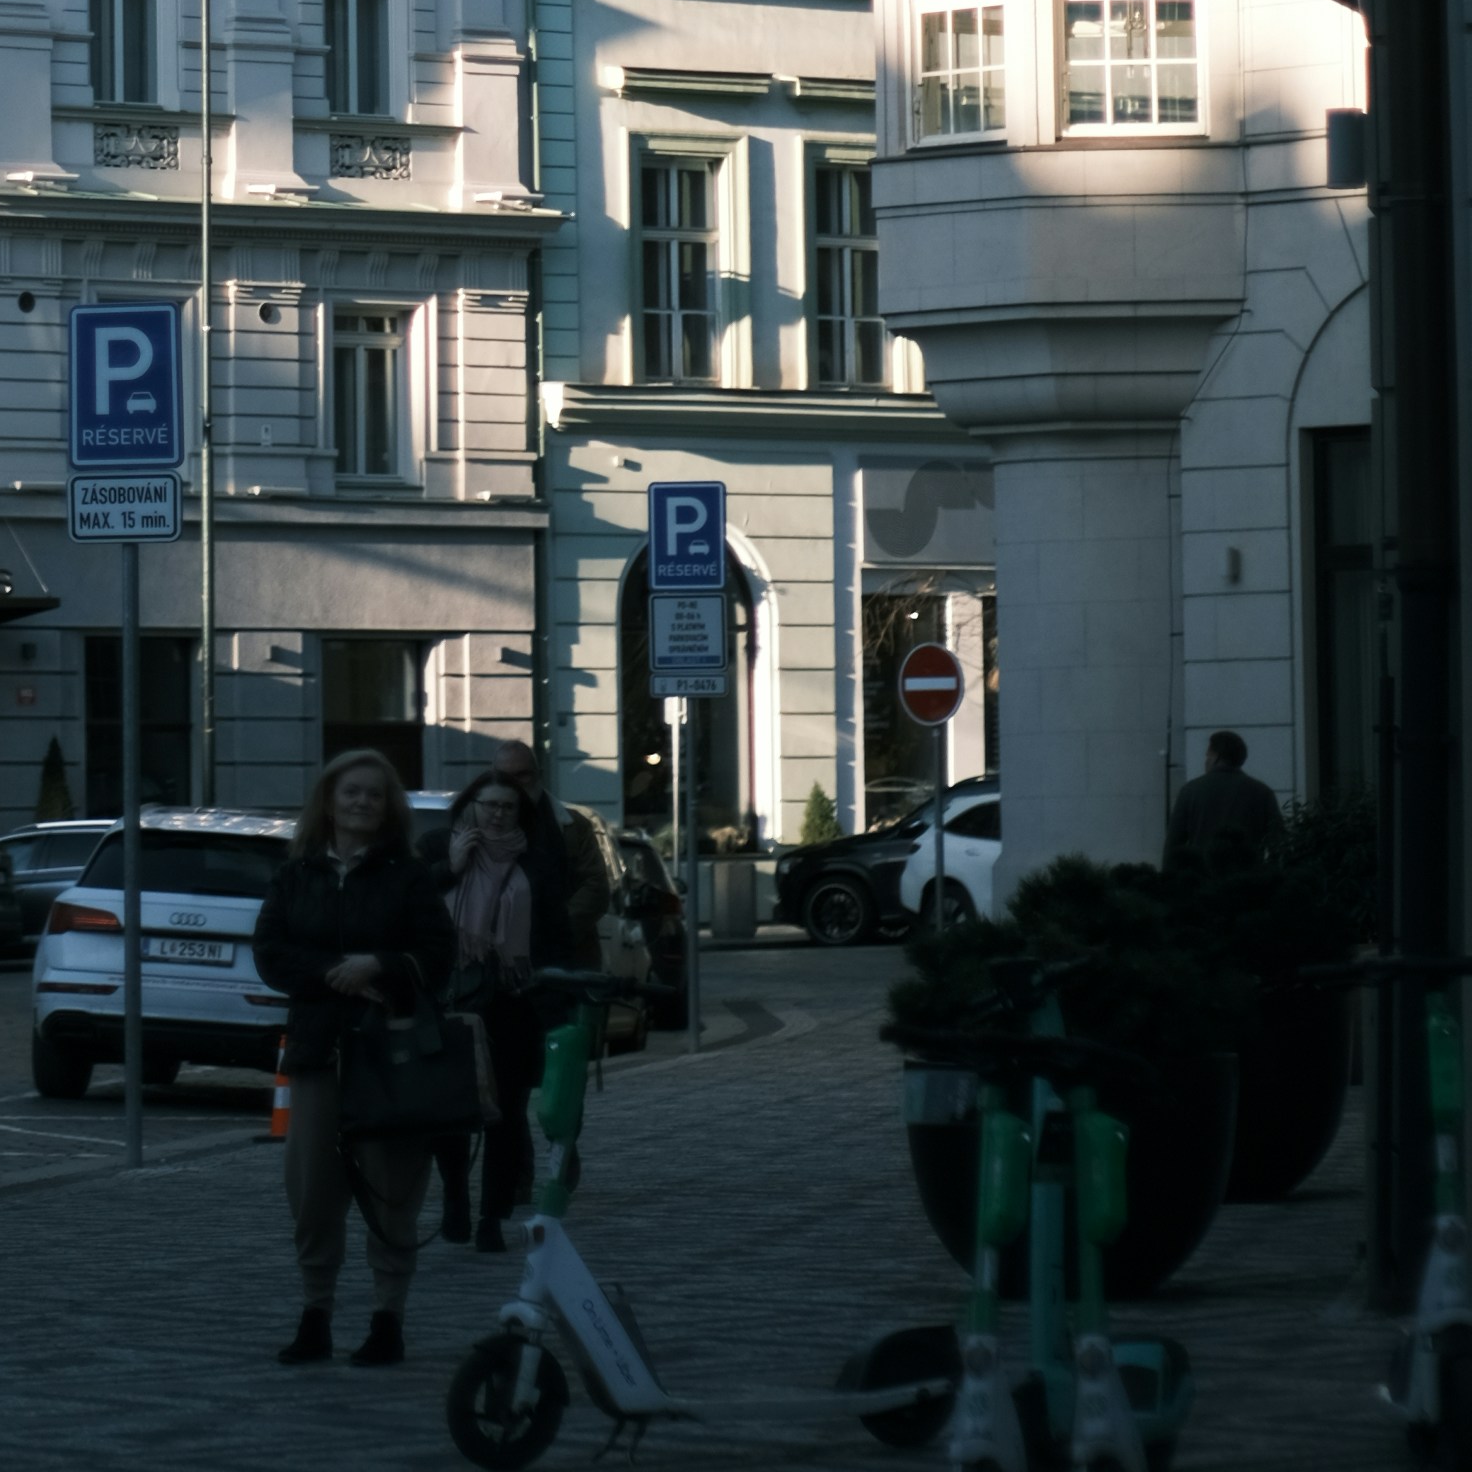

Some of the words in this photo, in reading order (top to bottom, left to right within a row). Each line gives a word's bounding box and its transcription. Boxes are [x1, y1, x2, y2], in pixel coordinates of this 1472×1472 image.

[95, 326, 153, 415] P
[82, 423, 168, 446] RÉSERVÉ
[81, 482, 168, 505] ZÁSOBOVÁNÍ
[79, 511, 114, 530] MAX.
[121, 511, 135, 529] 15
[141, 511, 170, 529] min.
[666, 496, 708, 556] P
[657, 561, 718, 578] RÉSERVÉ
[677, 679, 717, 691] P1-0476
